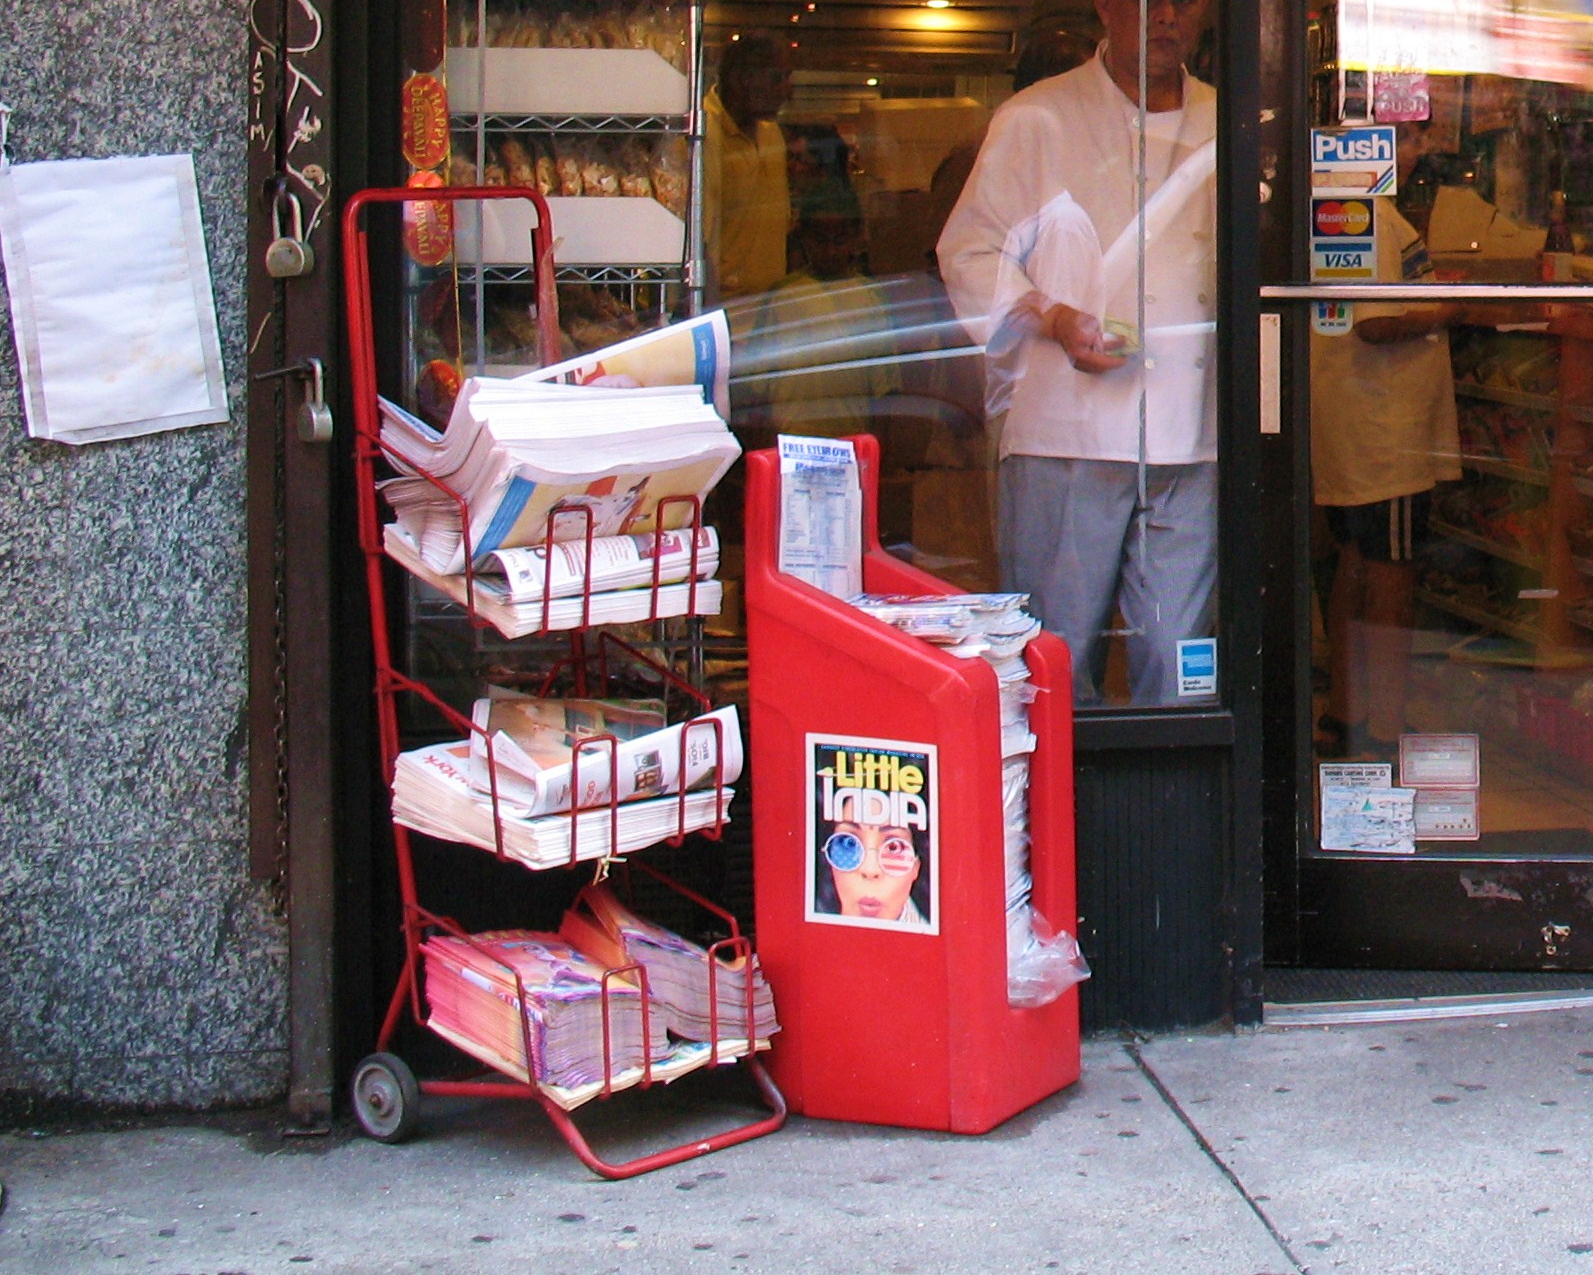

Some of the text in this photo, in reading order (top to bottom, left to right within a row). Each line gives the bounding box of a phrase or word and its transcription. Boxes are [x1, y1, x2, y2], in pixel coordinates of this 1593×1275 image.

[428, 91, 448, 149] HAPPY
[1315, 133, 1391, 161] Push
[1317, 213, 1370, 223] MasterCard
[1324, 254, 1363, 268] VISA
[835, 751, 924, 793] Little
